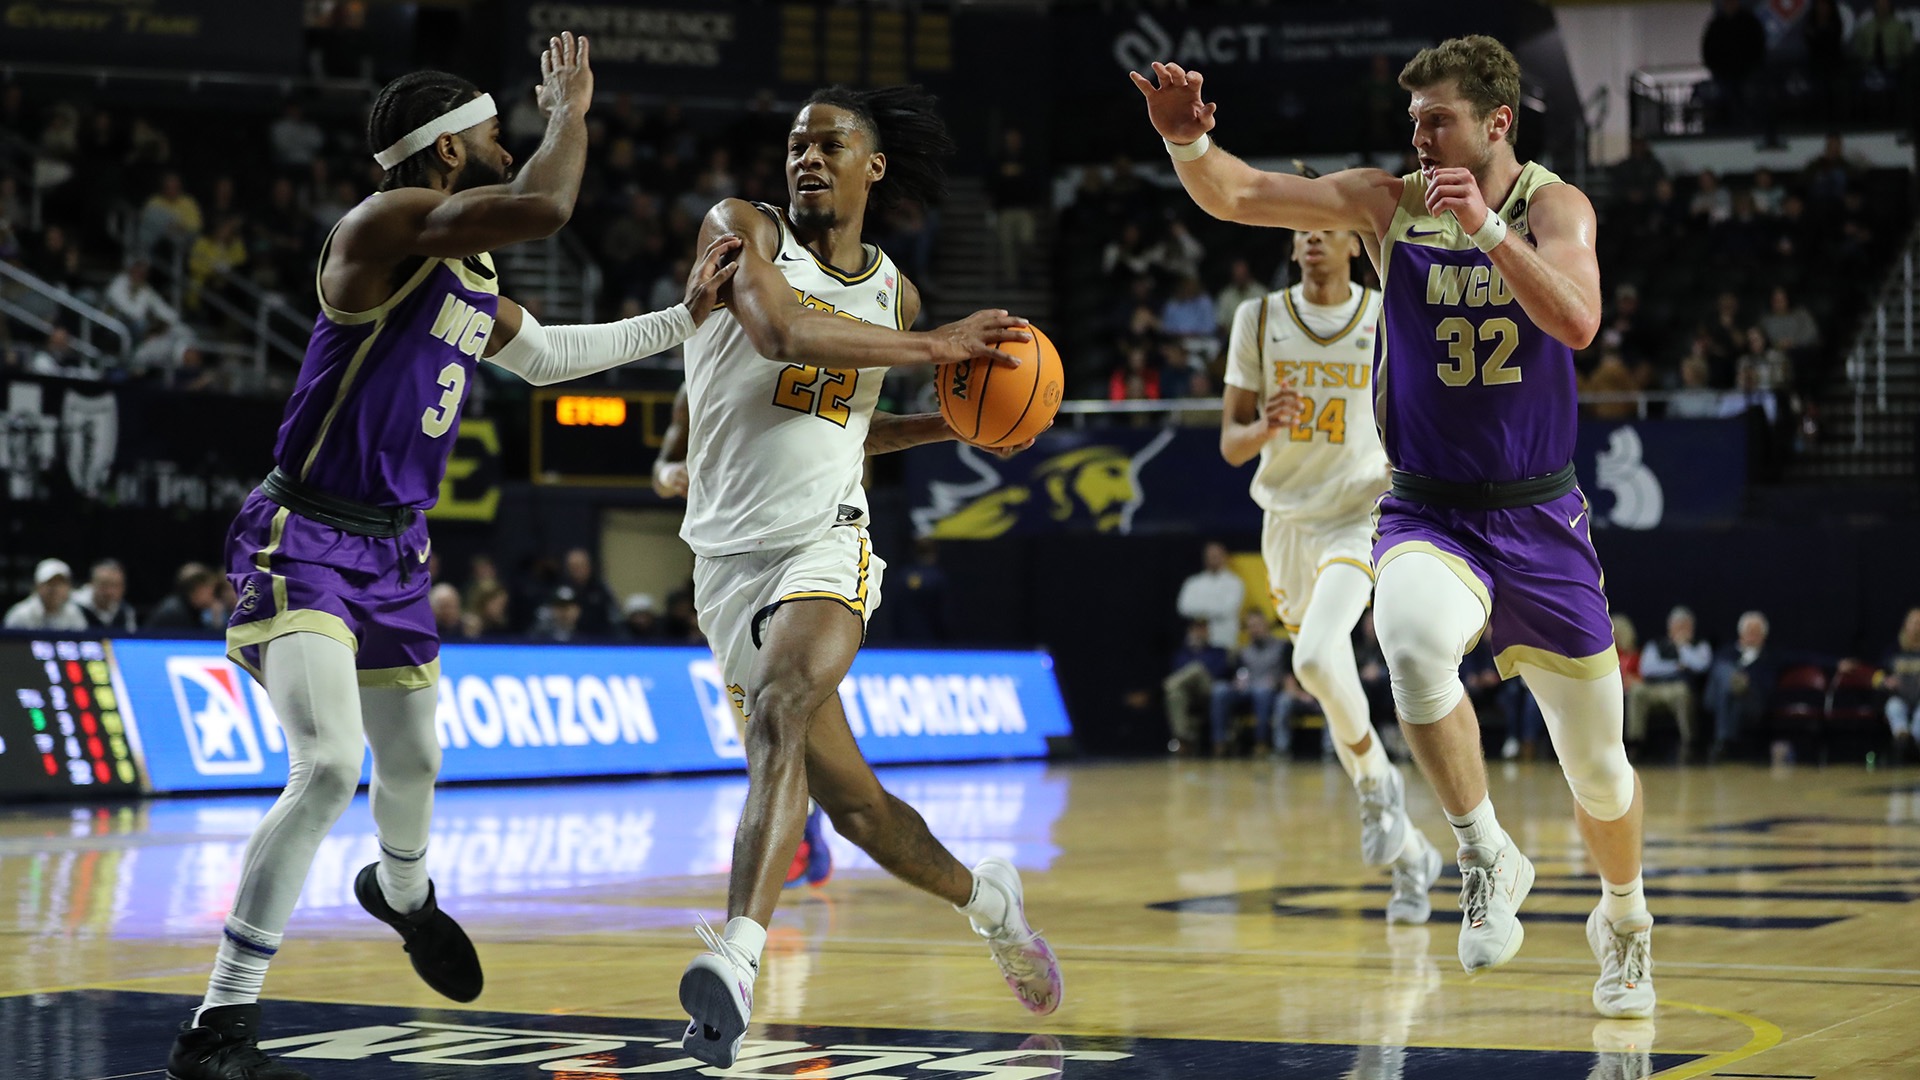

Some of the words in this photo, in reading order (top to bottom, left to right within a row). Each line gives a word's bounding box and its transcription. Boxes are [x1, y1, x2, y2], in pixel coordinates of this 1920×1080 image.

[529, 4, 736, 41] CONFERENCE
[1176, 24, 1268, 64] ACT
[1274, 360, 1371, 390] ETSU
[1435, 316, 1523, 387] 32
[421, 362, 466, 439] 3
[772, 363, 860, 429] 22
[1290, 396, 1347, 444] 24
[436, 672, 660, 750] HORIZON
[860, 672, 1028, 740] HORIZON
